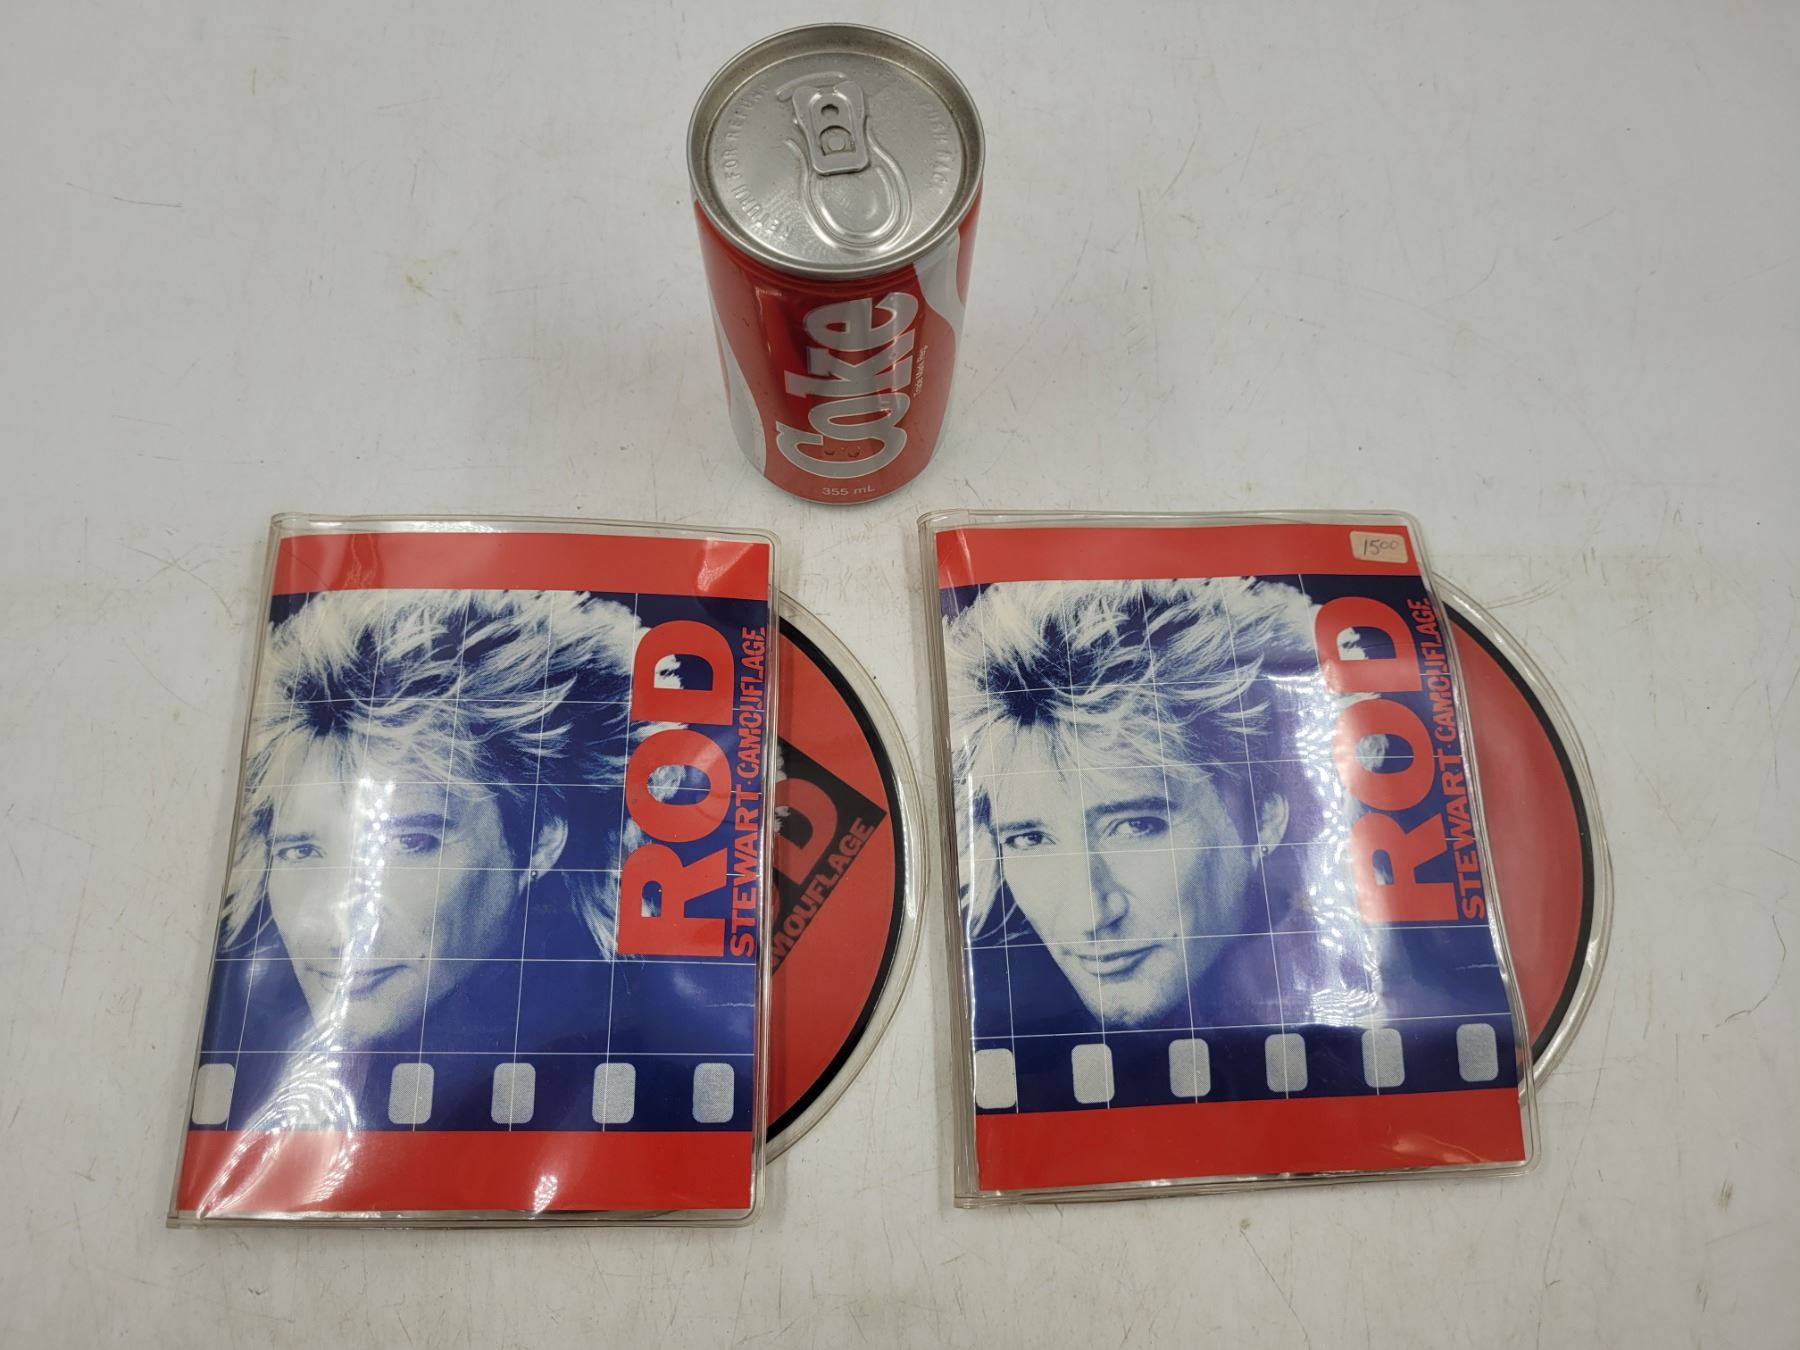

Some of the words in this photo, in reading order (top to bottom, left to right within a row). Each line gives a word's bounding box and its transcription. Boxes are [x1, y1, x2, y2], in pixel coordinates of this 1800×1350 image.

[776, 292, 918, 479] Coke
[821, 487, 849, 496] 355
[736, 626, 767, 780] CAMOUFLAGE
[1406, 598, 1457, 742] CAMOUFLAGE
[617, 619, 735, 957] ROD
[1314, 596, 1459, 923] ROD
[1437, 752, 1486, 921] STEWART
[729, 784, 762, 958] STEWART
[772, 816, 875, 968] MOUFLAGE
